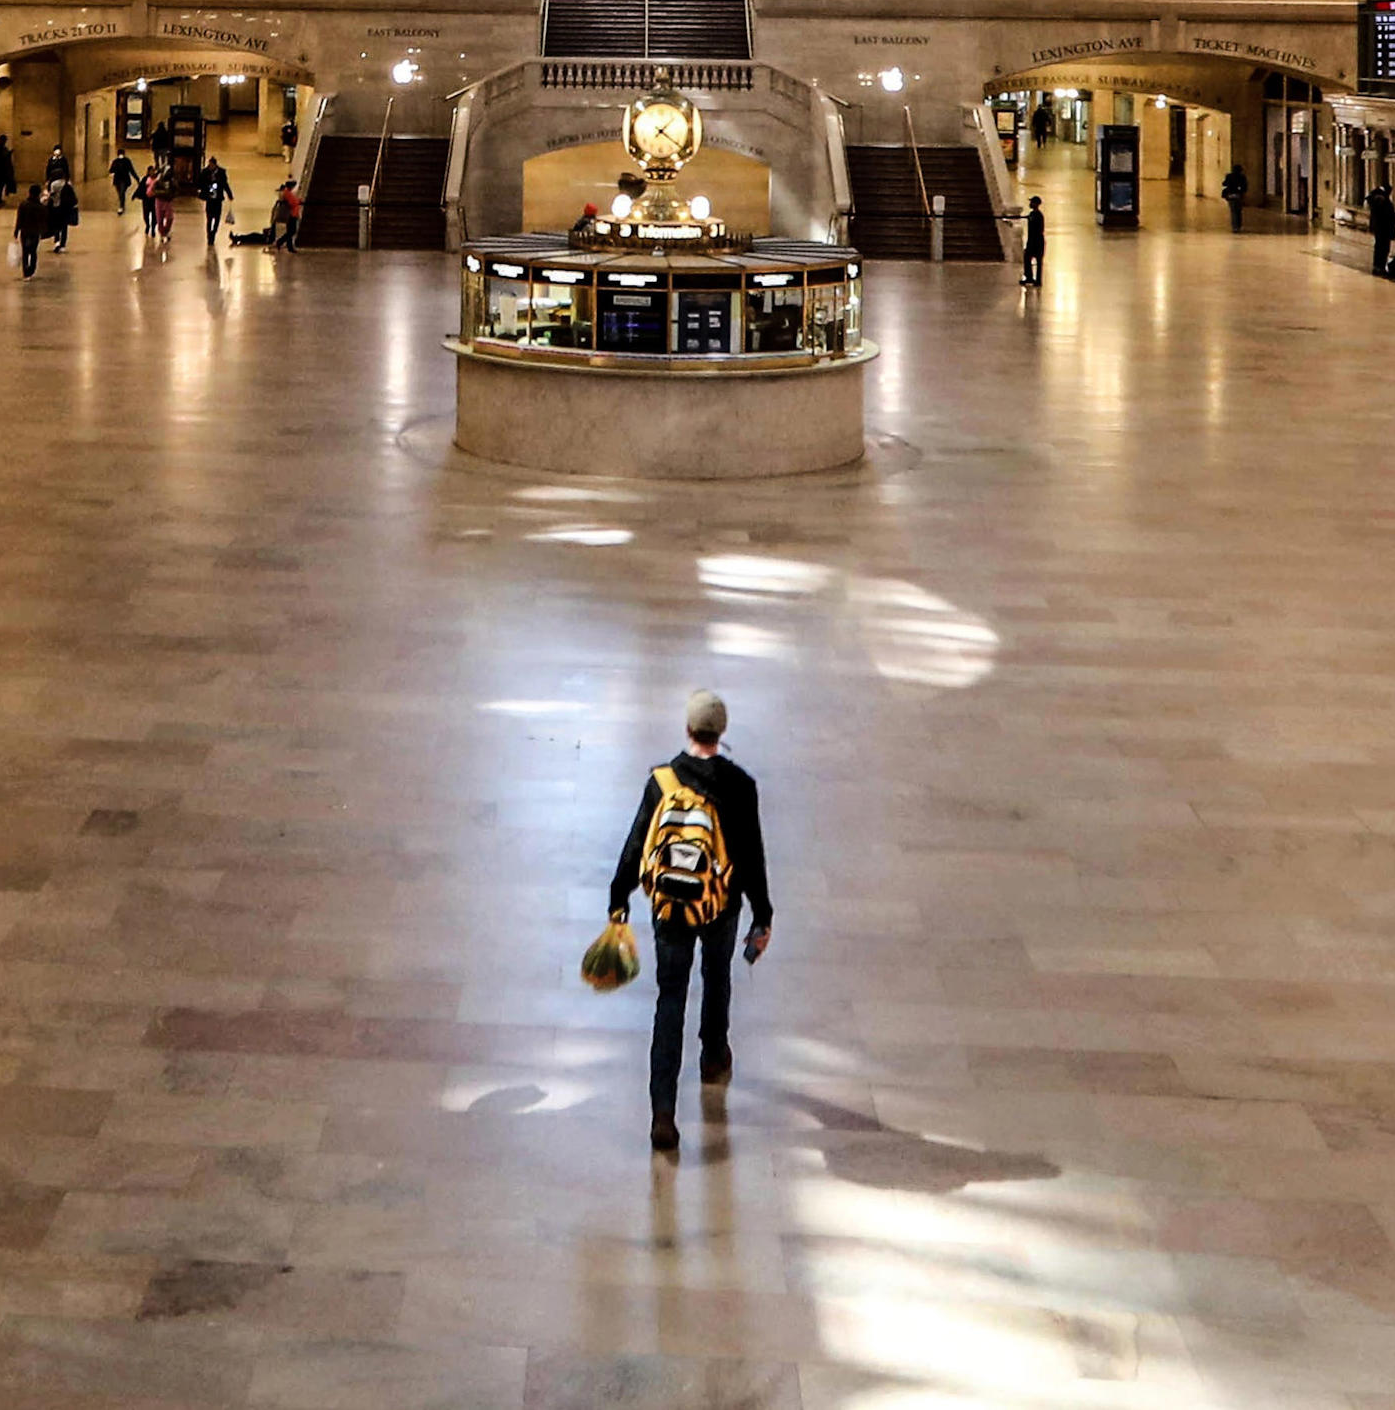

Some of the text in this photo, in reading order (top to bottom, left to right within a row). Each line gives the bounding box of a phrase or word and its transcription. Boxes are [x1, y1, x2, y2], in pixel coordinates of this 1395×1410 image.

[18, 28, 68, 45] TRACKS
[85, 24, 105, 35] TO
[163, 23, 269, 51] LEXINGTON AVE
[367, 28, 440, 38] EAST BALCONY
[1031, 37, 1144, 63] LEXINGTON AVE
[1193, 38, 1317, 69] TICKET MACHINES
